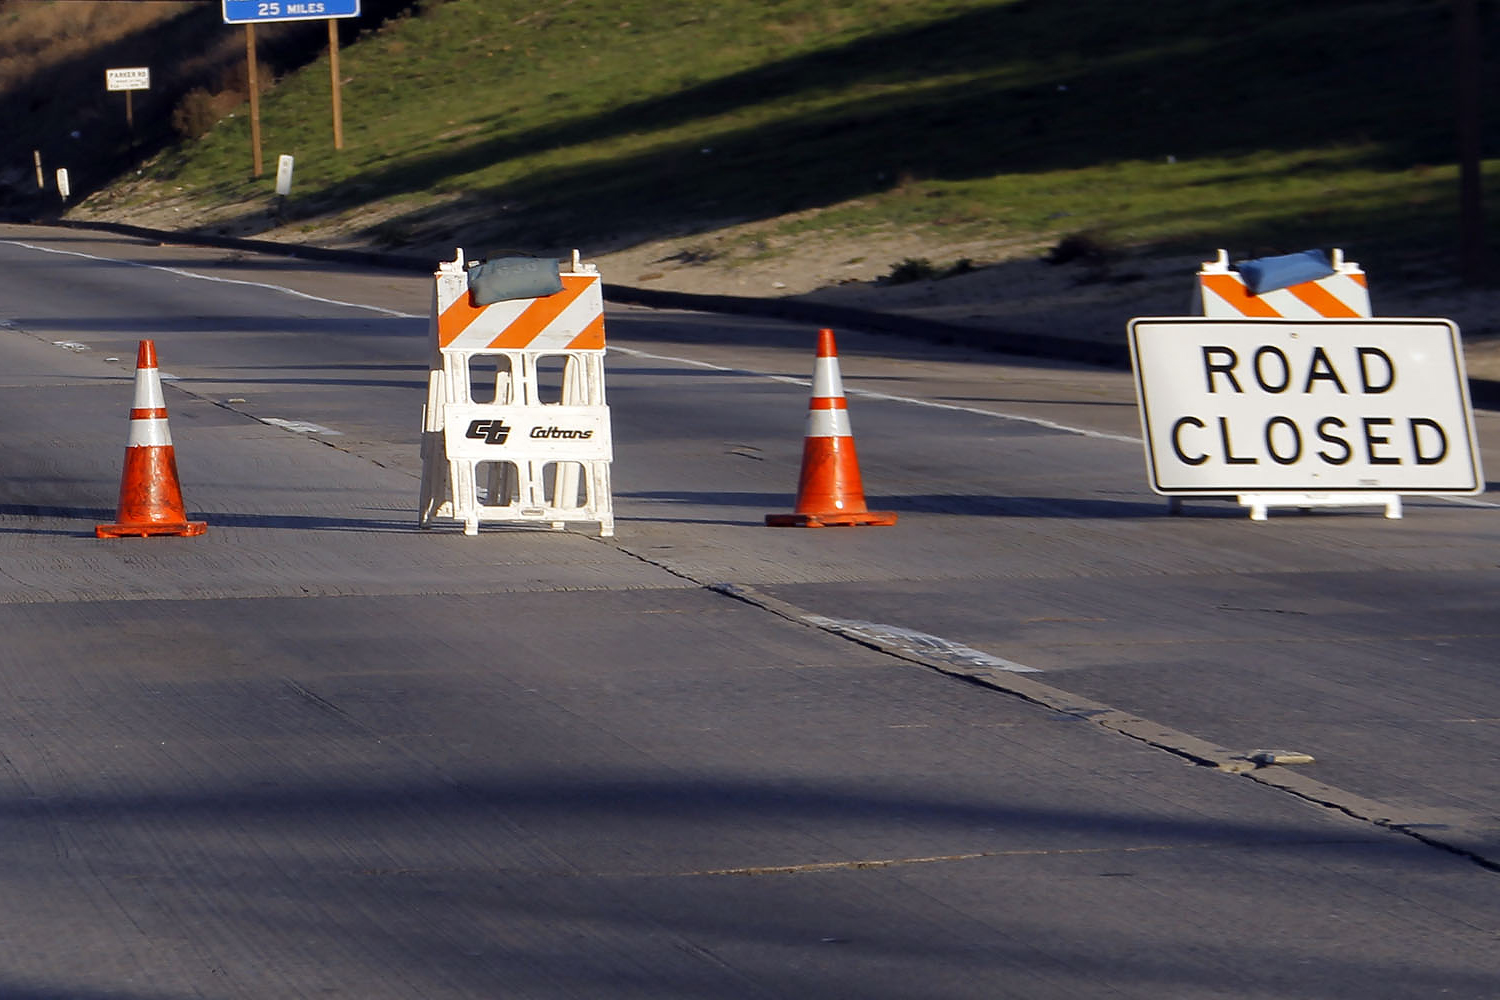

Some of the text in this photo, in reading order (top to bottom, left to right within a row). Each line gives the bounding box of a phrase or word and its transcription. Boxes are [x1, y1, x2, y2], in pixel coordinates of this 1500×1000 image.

[258, 3, 325, 16] 25 MILES
[1200, 345, 1396, 394] ROAD
[529, 425, 594, 439] Caltrans
[1171, 416, 1448, 466] CLOSED
